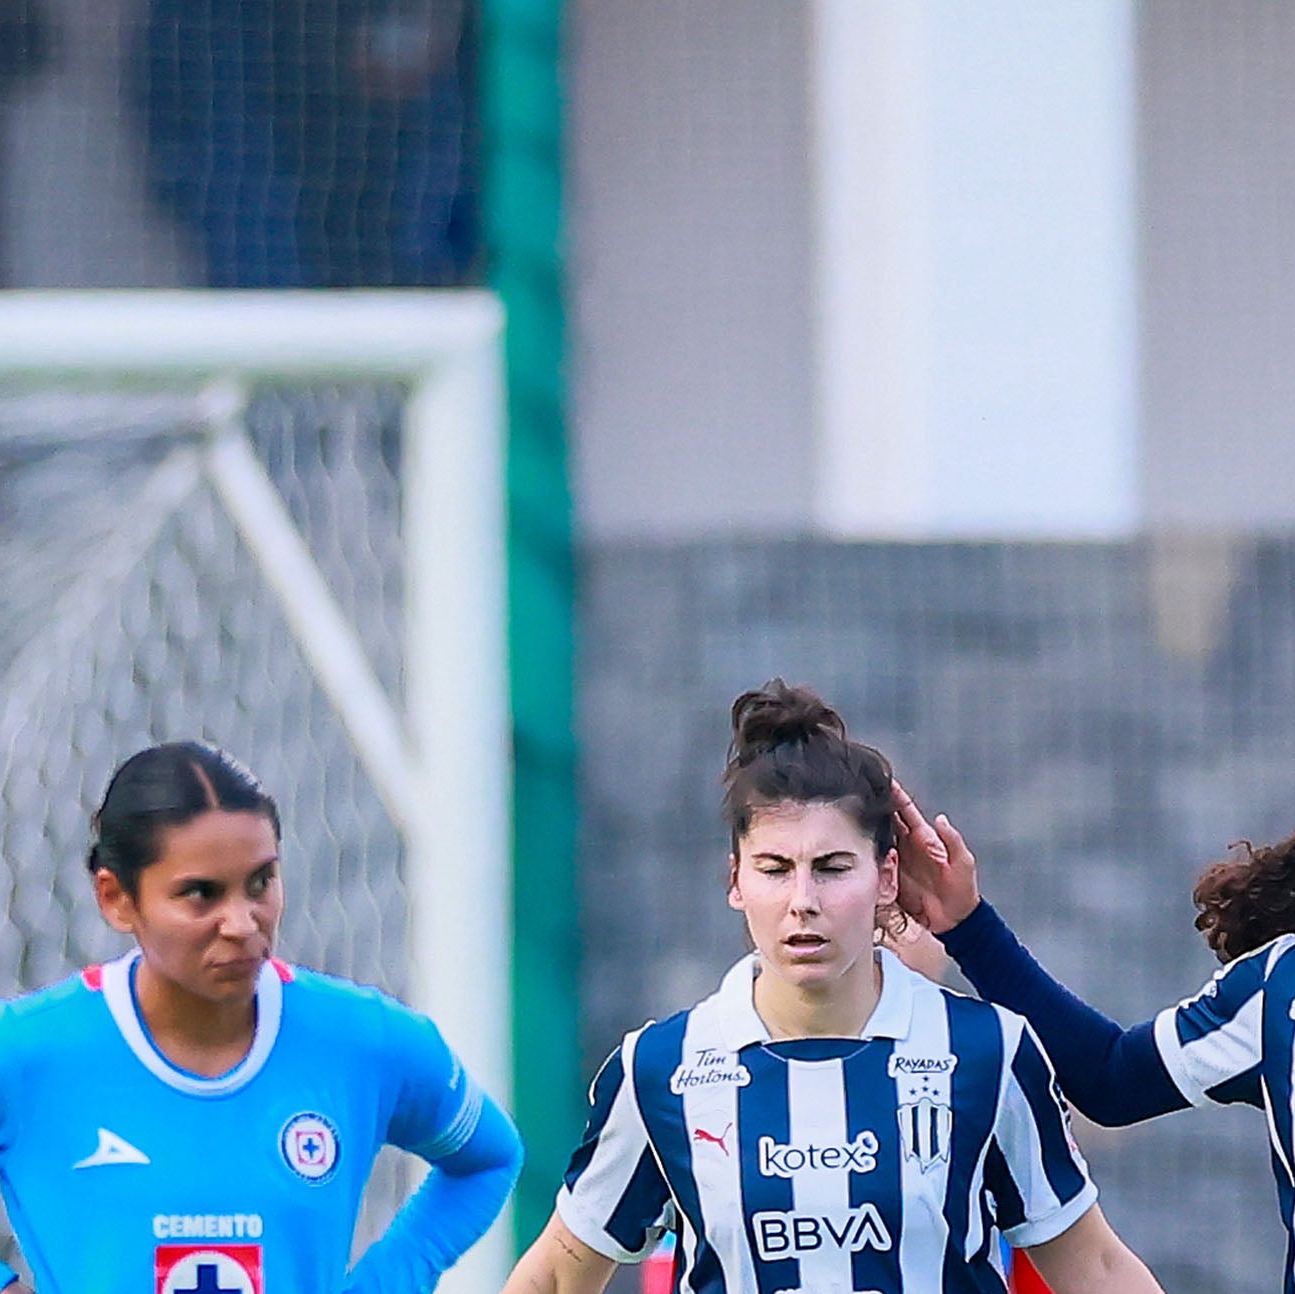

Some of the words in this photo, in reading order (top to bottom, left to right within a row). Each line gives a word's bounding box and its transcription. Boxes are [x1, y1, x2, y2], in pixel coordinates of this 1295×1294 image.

[695, 1048, 727, 1068] Tim
[894, 1057, 952, 1073] RAYADAS
[676, 1069, 743, 1089] Hortons
[764, 1141, 863, 1171] kotex
[153, 1214, 263, 1238] CEMENTO
[760, 1214, 888, 1252] BBVA
